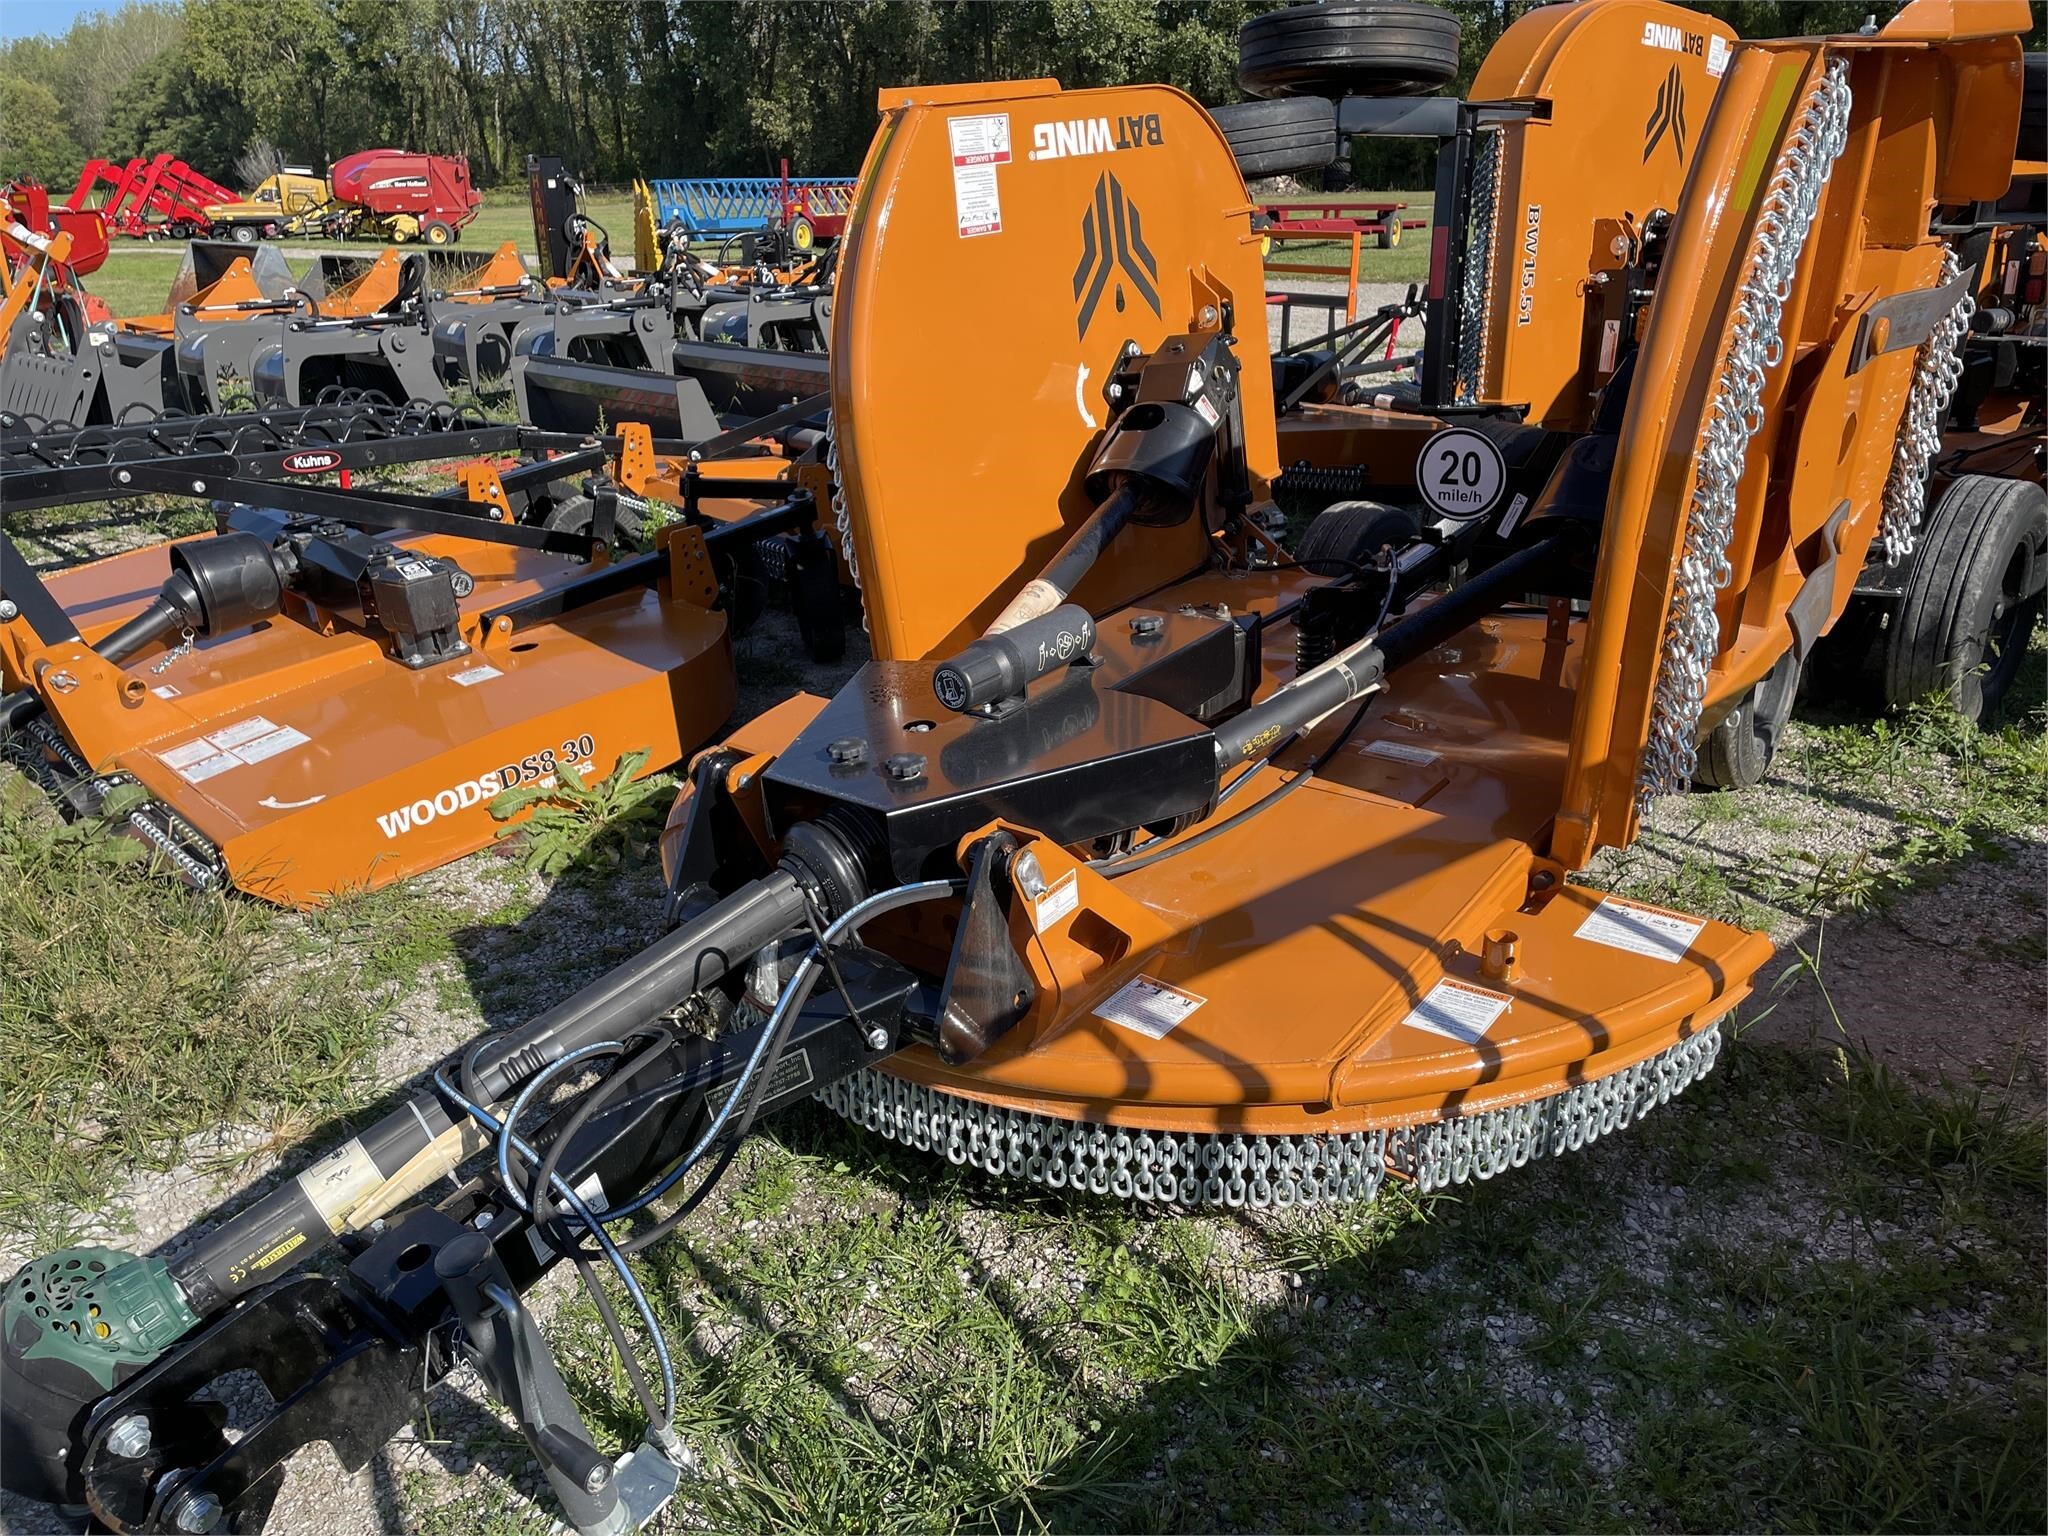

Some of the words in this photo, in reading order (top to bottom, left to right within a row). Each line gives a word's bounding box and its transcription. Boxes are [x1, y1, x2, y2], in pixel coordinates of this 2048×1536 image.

[1033, 113, 1165, 161] BATWING
[965, 154, 989, 164] DANGER
[293, 455, 332, 469] Kuhns
[1439, 449, 1482, 487] 20
[1438, 489, 1482, 503] mile/h
[376, 771, 501, 839] WOODS
[497, 734, 595, 790] DS830
[1637, 905, 1688, 921] WARNING
[1460, 984, 1505, 1000] WARNING
